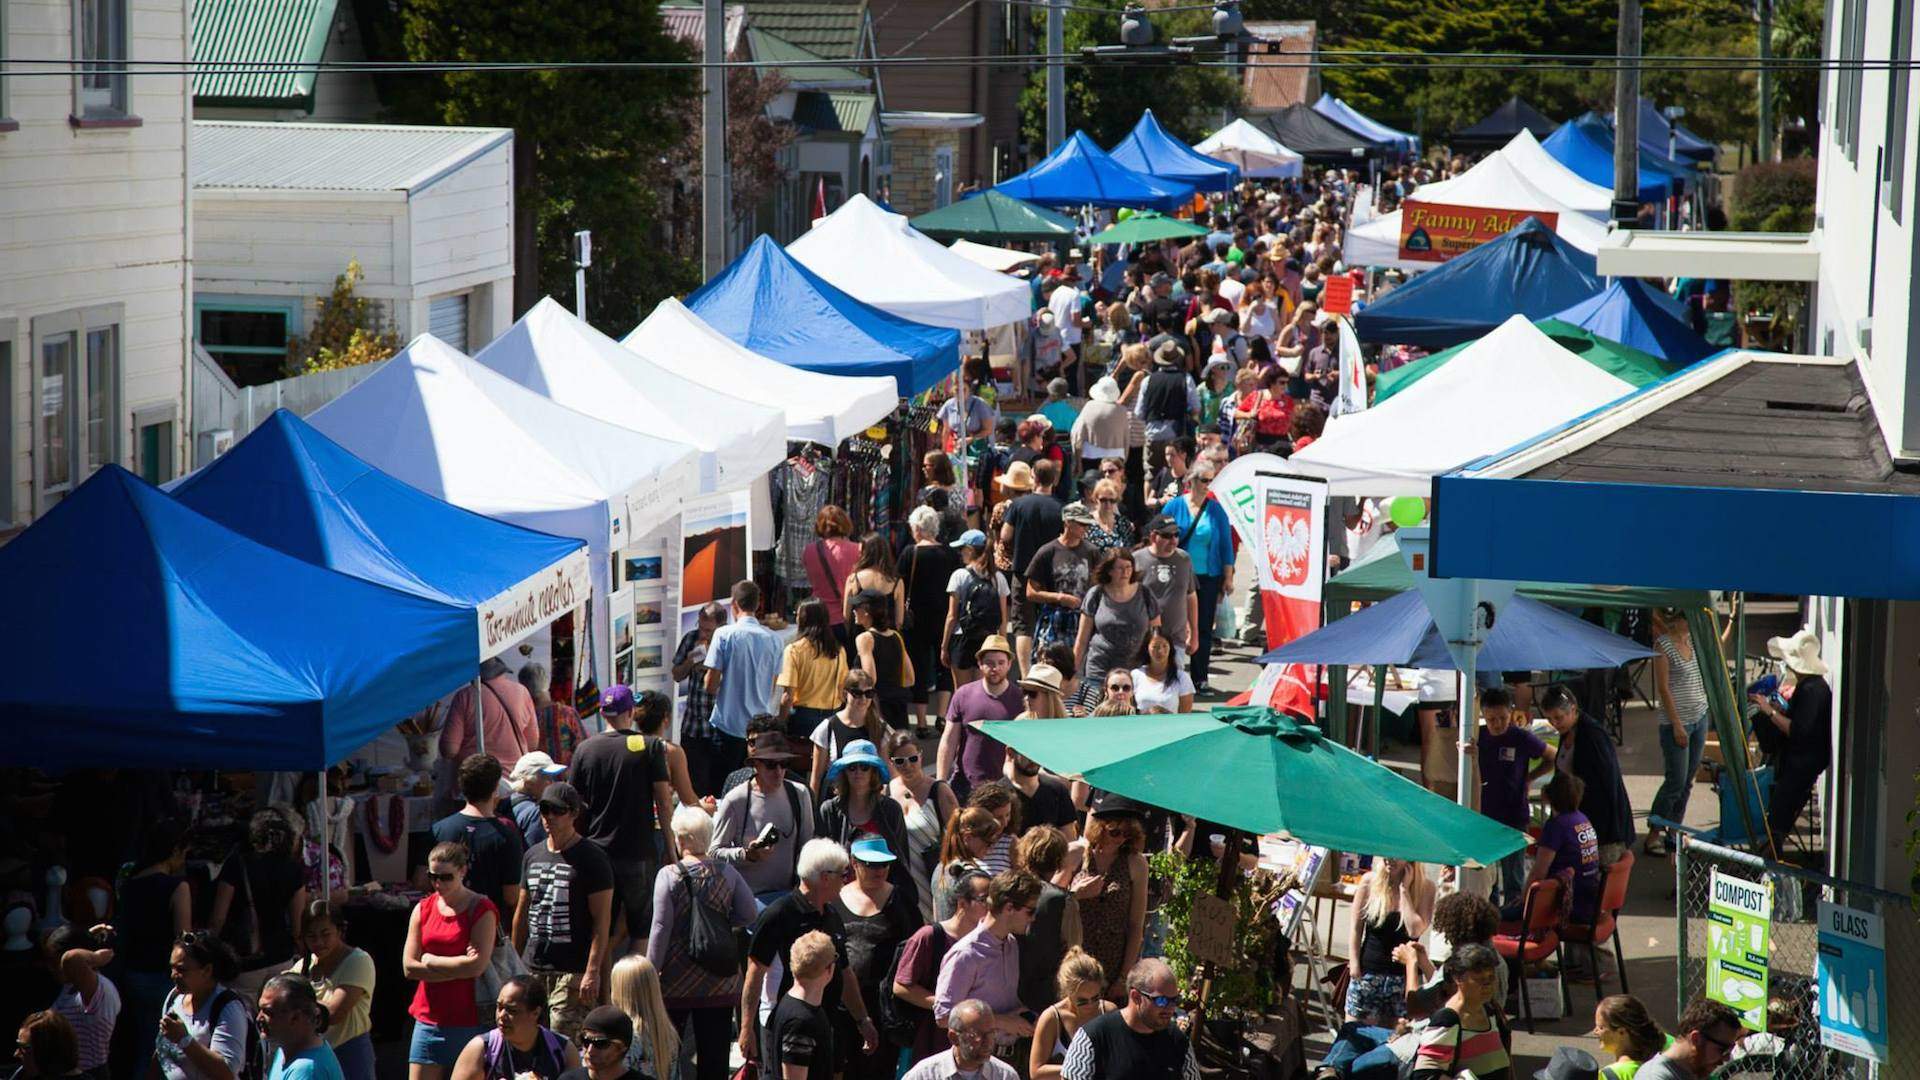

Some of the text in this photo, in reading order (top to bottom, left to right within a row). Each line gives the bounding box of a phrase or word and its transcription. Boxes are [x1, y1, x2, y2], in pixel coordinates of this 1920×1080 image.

[1410, 208, 1476, 239] Fanny
[539, 568, 575, 619] needles
[1715, 880, 1764, 912] COMPOST
[1833, 911, 1868, 939] GLASS
